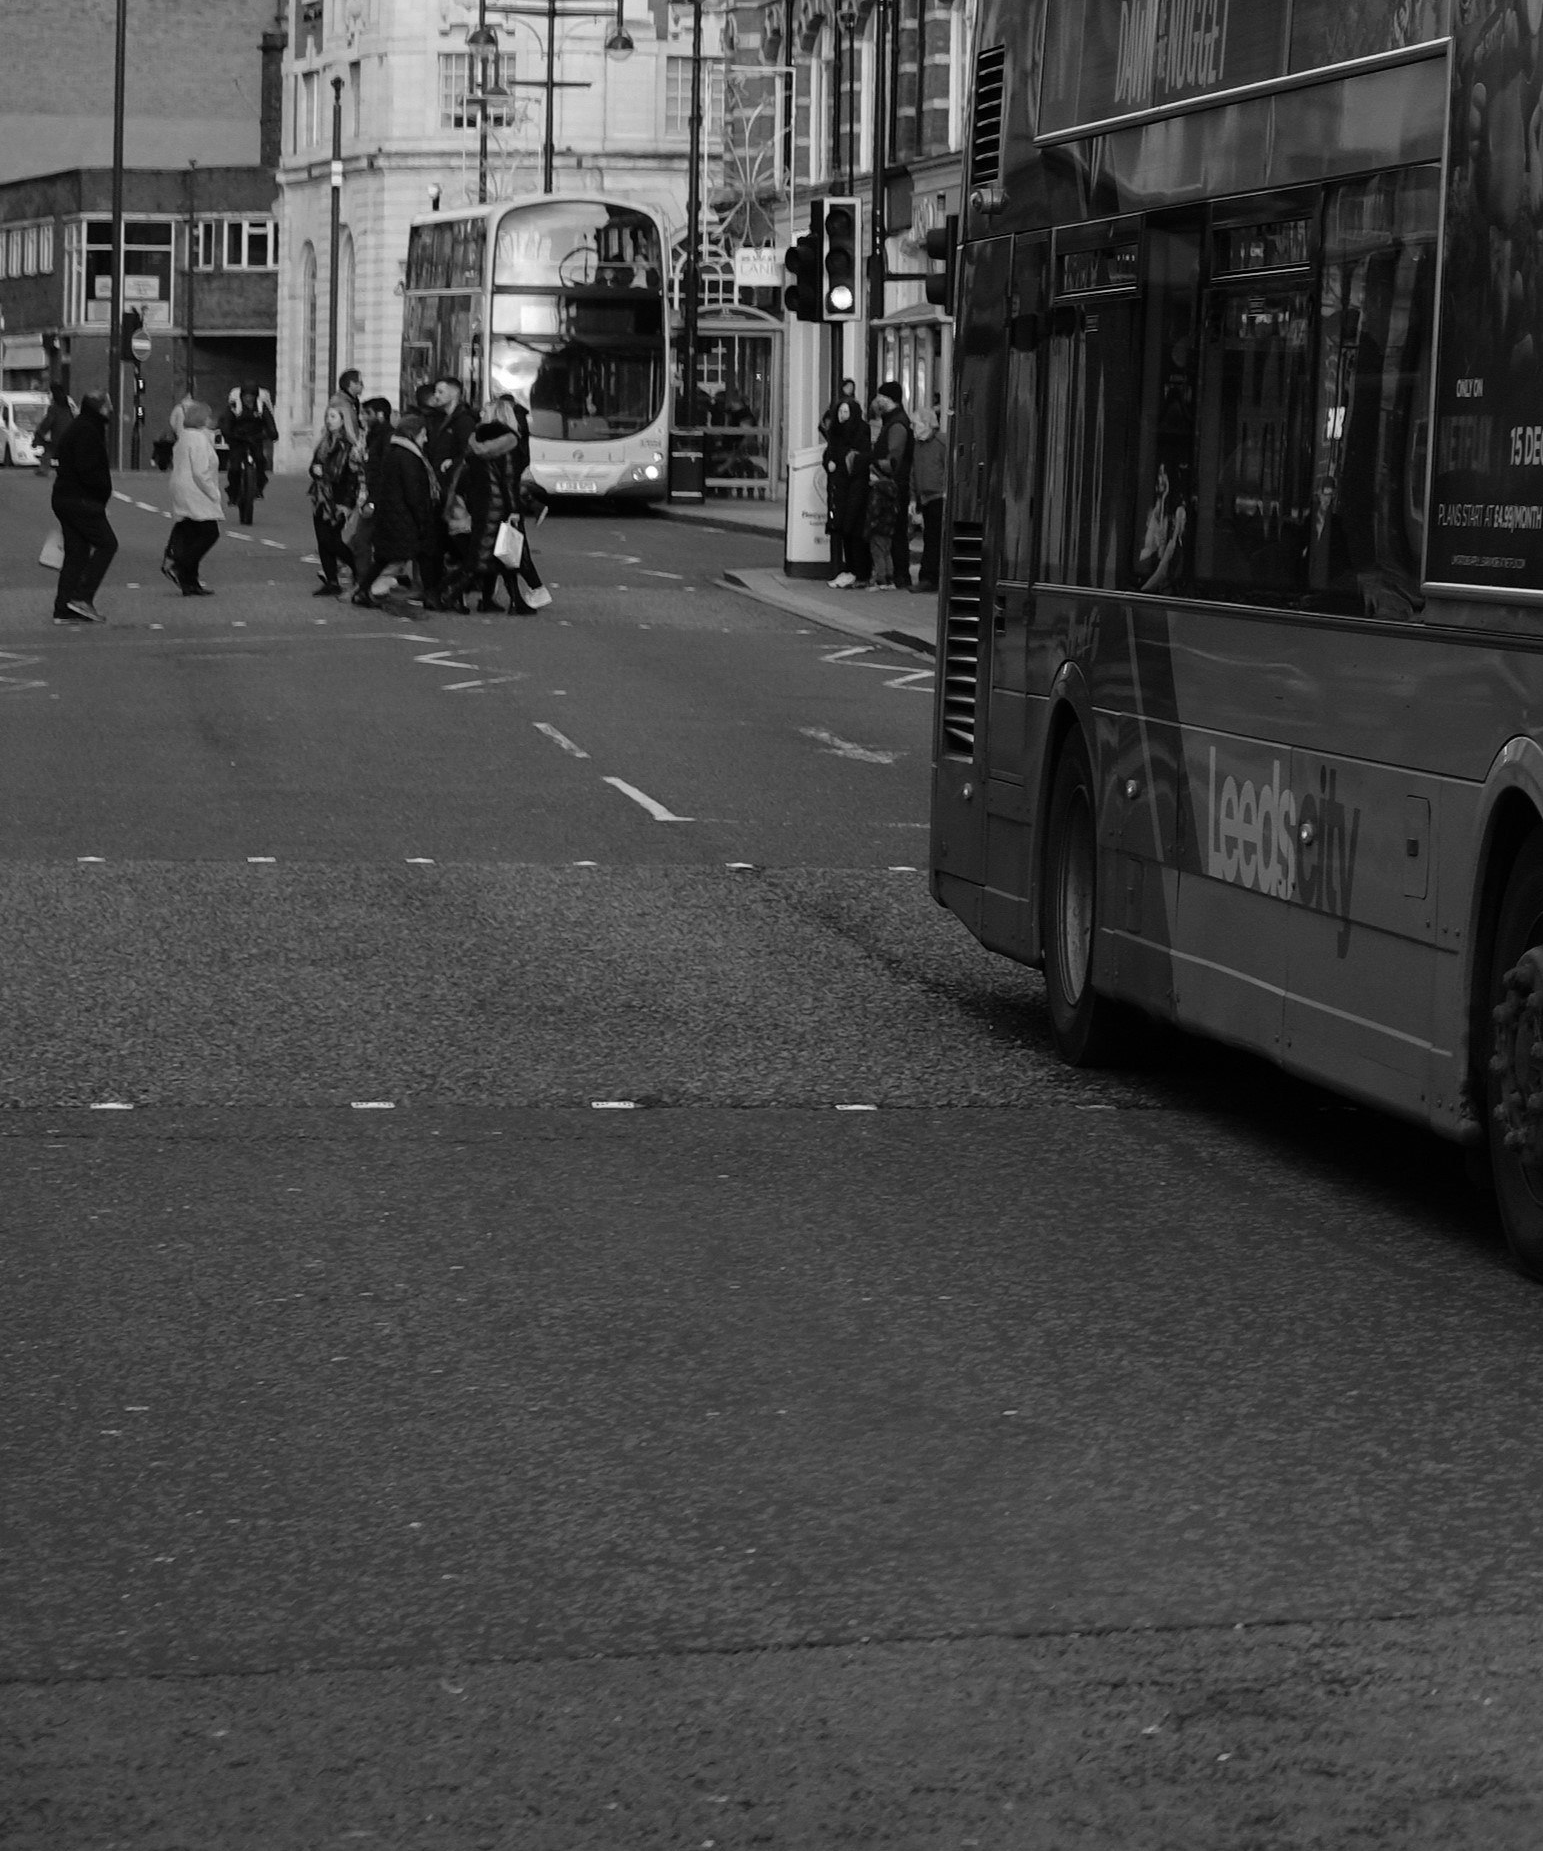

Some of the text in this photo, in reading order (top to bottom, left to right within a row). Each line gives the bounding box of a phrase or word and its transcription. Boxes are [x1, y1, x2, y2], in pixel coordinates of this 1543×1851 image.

[1473, 378, 1484, 398] ON
[1510, 426, 1524, 466] 15
[1438, 503, 1462, 527] PLANS
[1462, 504, 1484, 528] START
